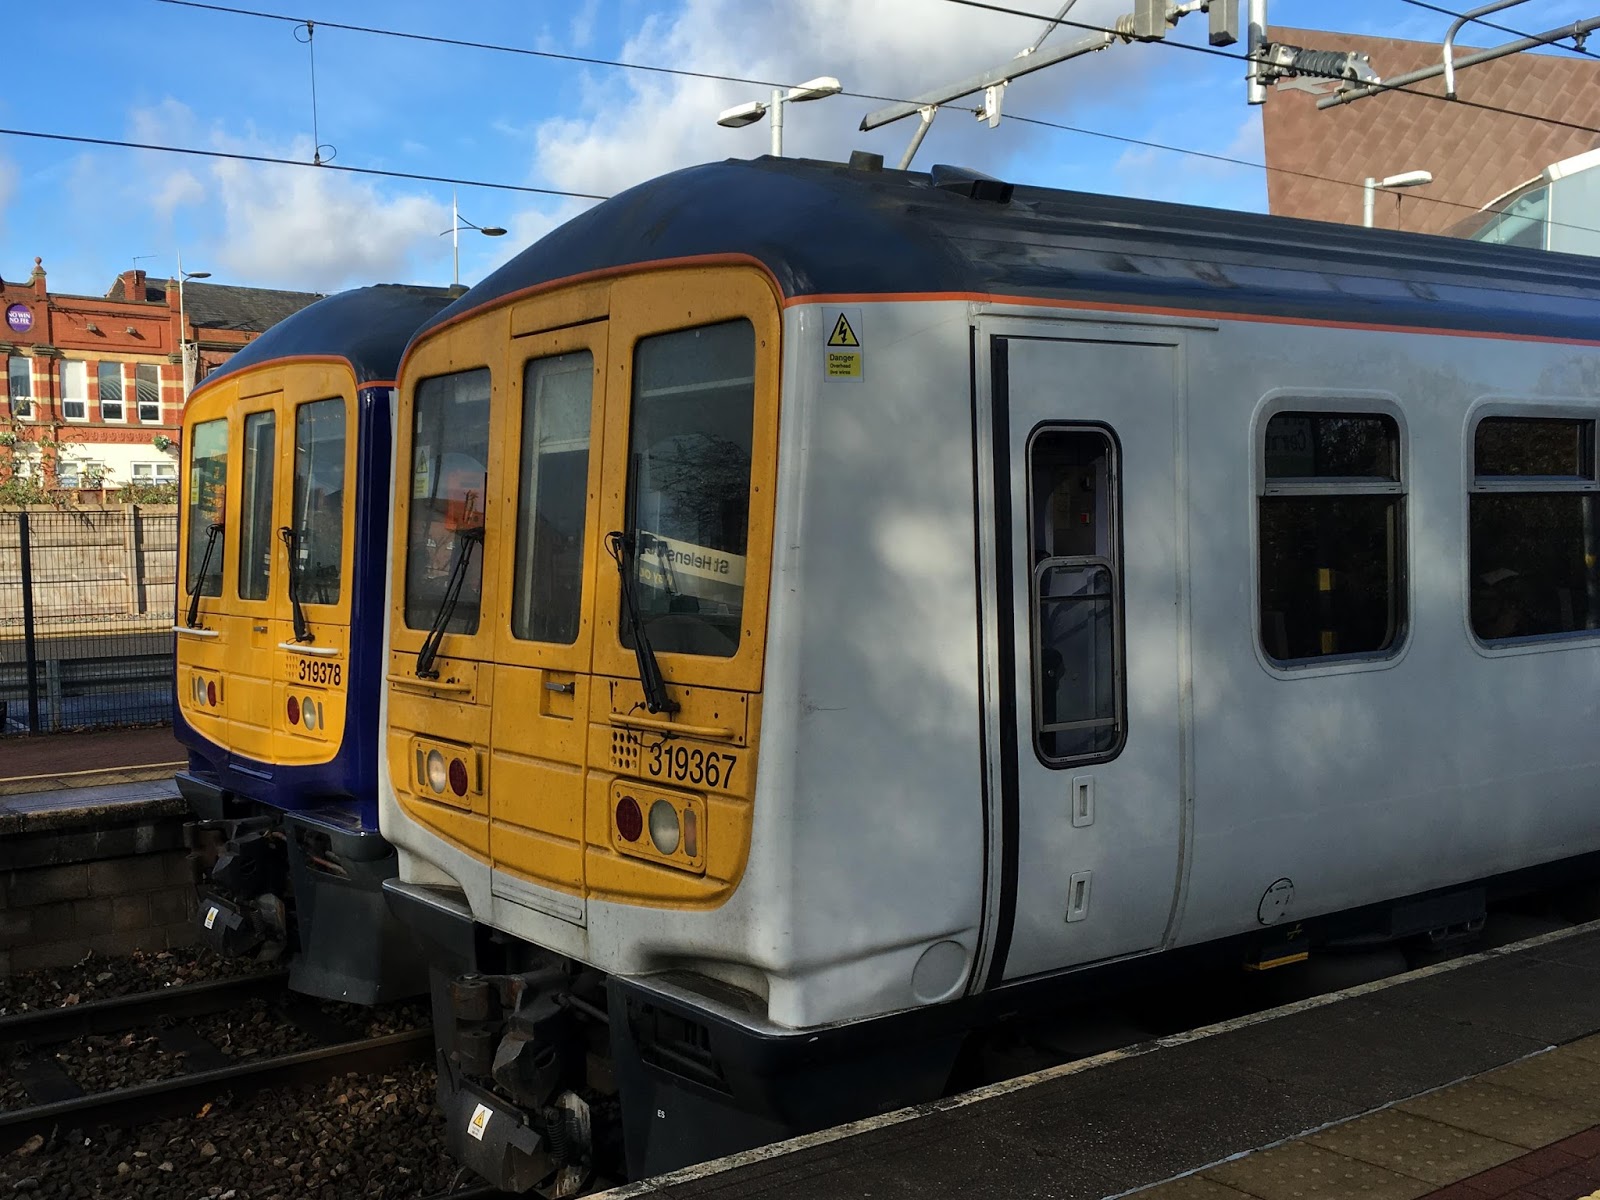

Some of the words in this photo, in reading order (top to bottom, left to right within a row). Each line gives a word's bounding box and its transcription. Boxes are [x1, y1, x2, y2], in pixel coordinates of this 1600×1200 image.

[830, 354, 854, 363] Danger
[298, 659, 341, 686] 319378
[648, 742, 737, 789] 319367
